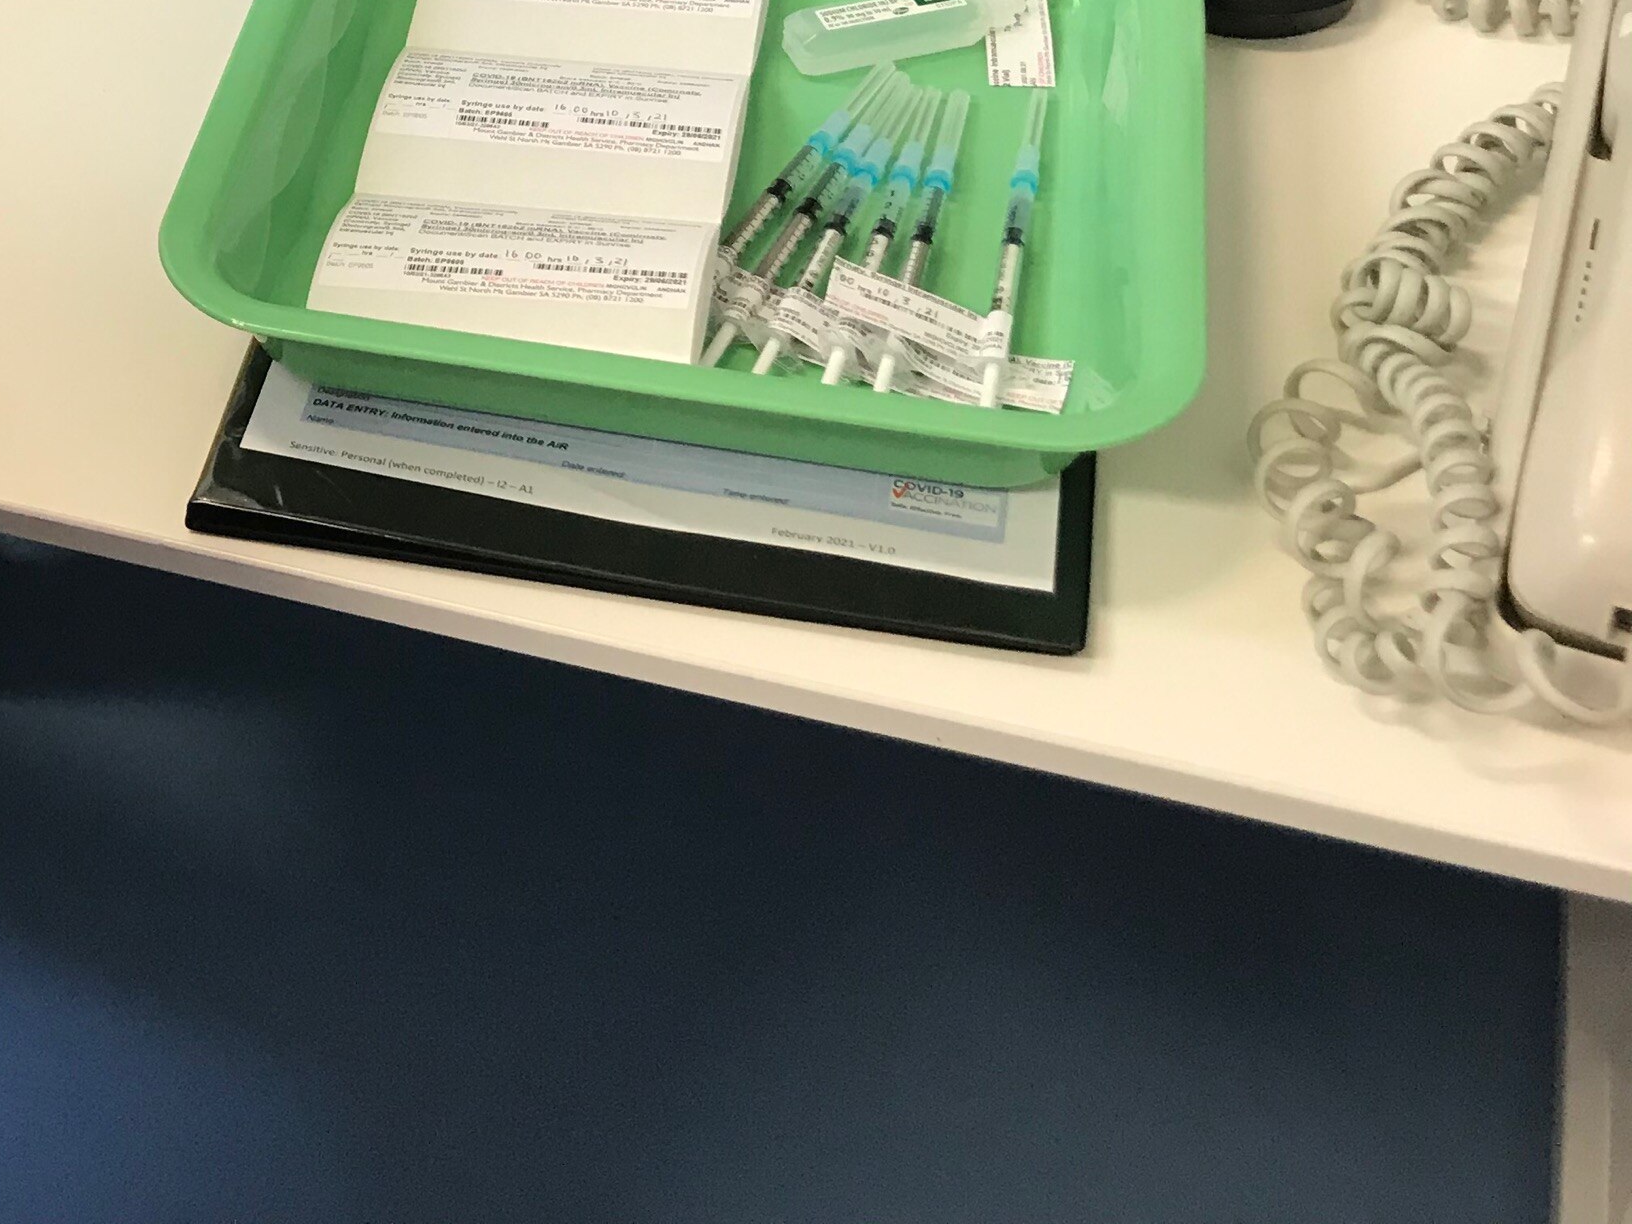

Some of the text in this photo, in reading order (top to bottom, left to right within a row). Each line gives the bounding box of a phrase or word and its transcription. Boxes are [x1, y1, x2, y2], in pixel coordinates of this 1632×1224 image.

[312, 398, 344, 411] DATA
[346, 403, 389, 417] ENTRY:
[391, 411, 455, 429] Information
[457, 424, 500, 438] entered
[501, 431, 524, 443] into
[526, 436, 545, 447] the
[341, 450, 386, 467] Personal
[388, 458, 422, 474] (when
[423, 464, 485, 487] completed)
[518, 483, 534, 495] A1
[892, 479, 965, 499] COVID-19
[771, 527, 896, 555] February 2021 V1.0
